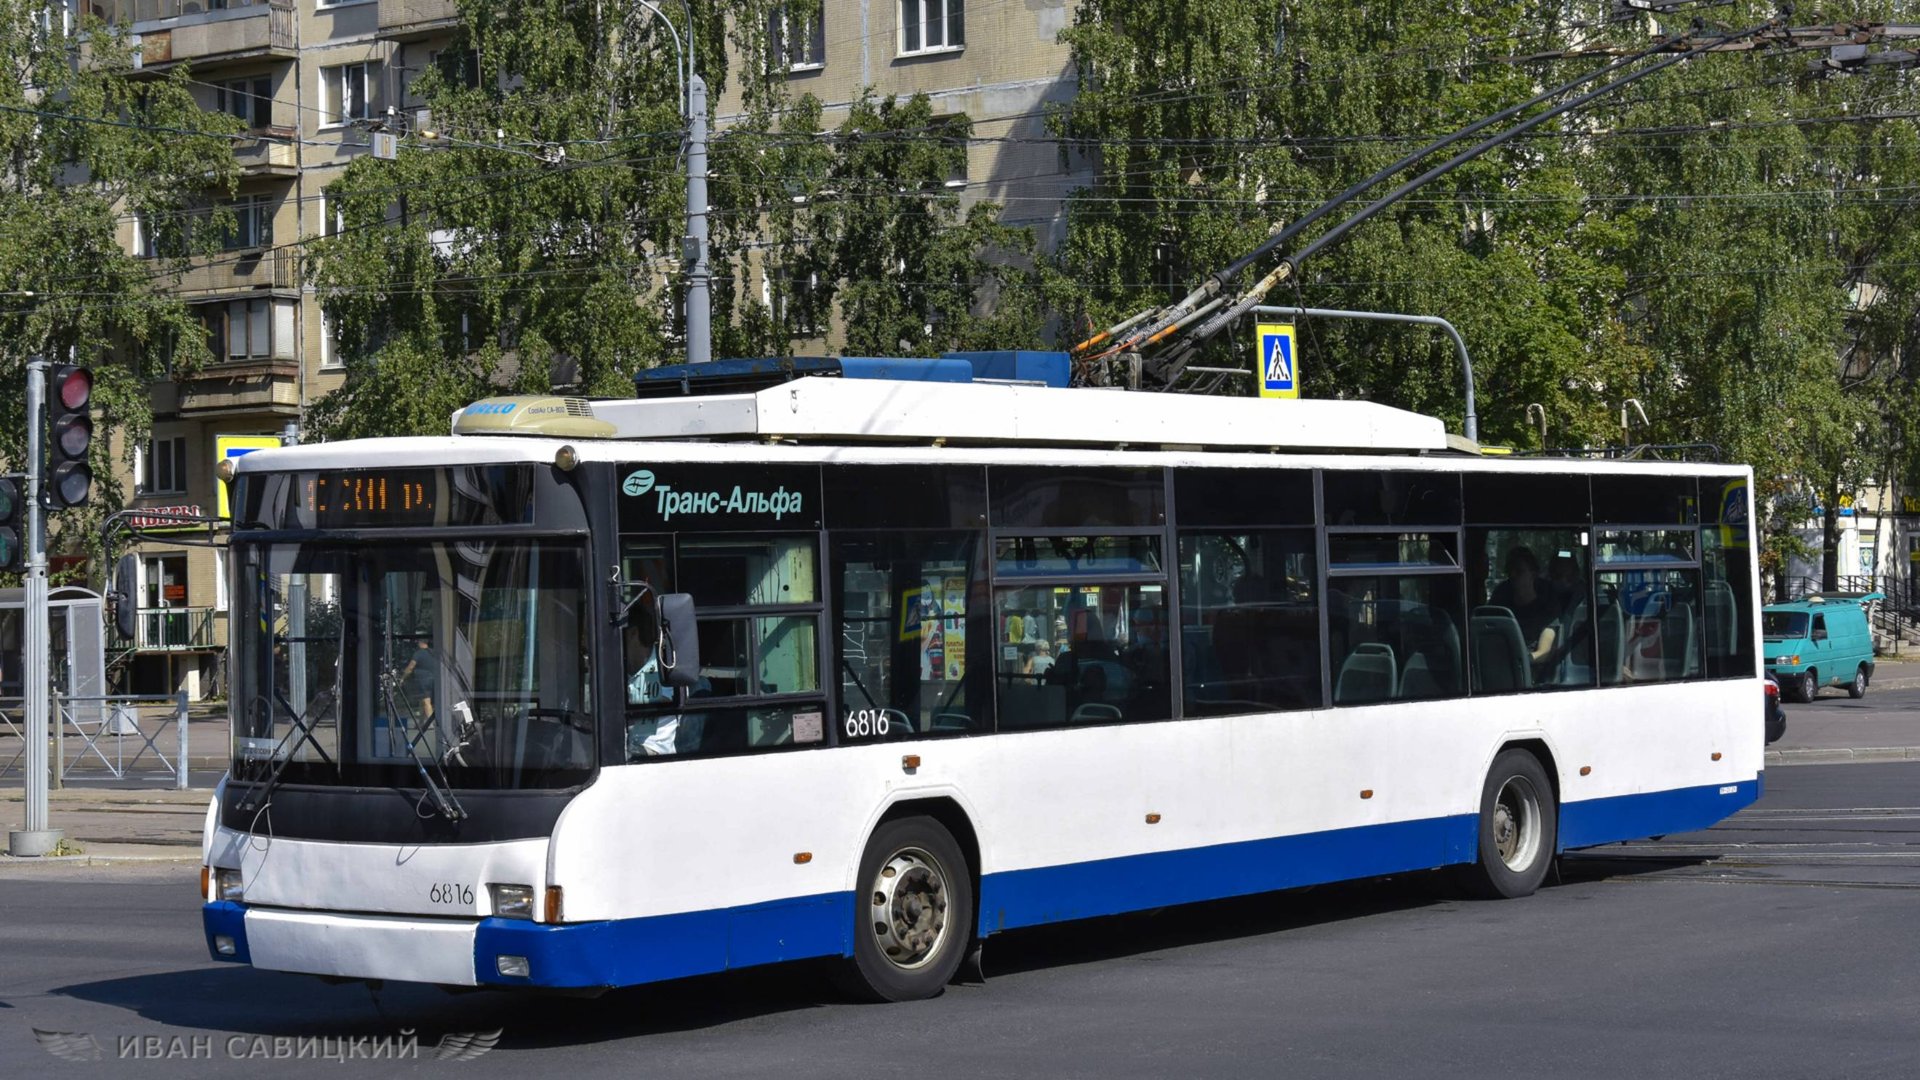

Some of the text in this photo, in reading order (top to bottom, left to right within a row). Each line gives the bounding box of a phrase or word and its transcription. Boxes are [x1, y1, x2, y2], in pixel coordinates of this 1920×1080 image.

[654, 485, 802, 522] Транс-Альфа
[846, 708, 889, 737] 6816
[430, 882, 474, 905] 6816
